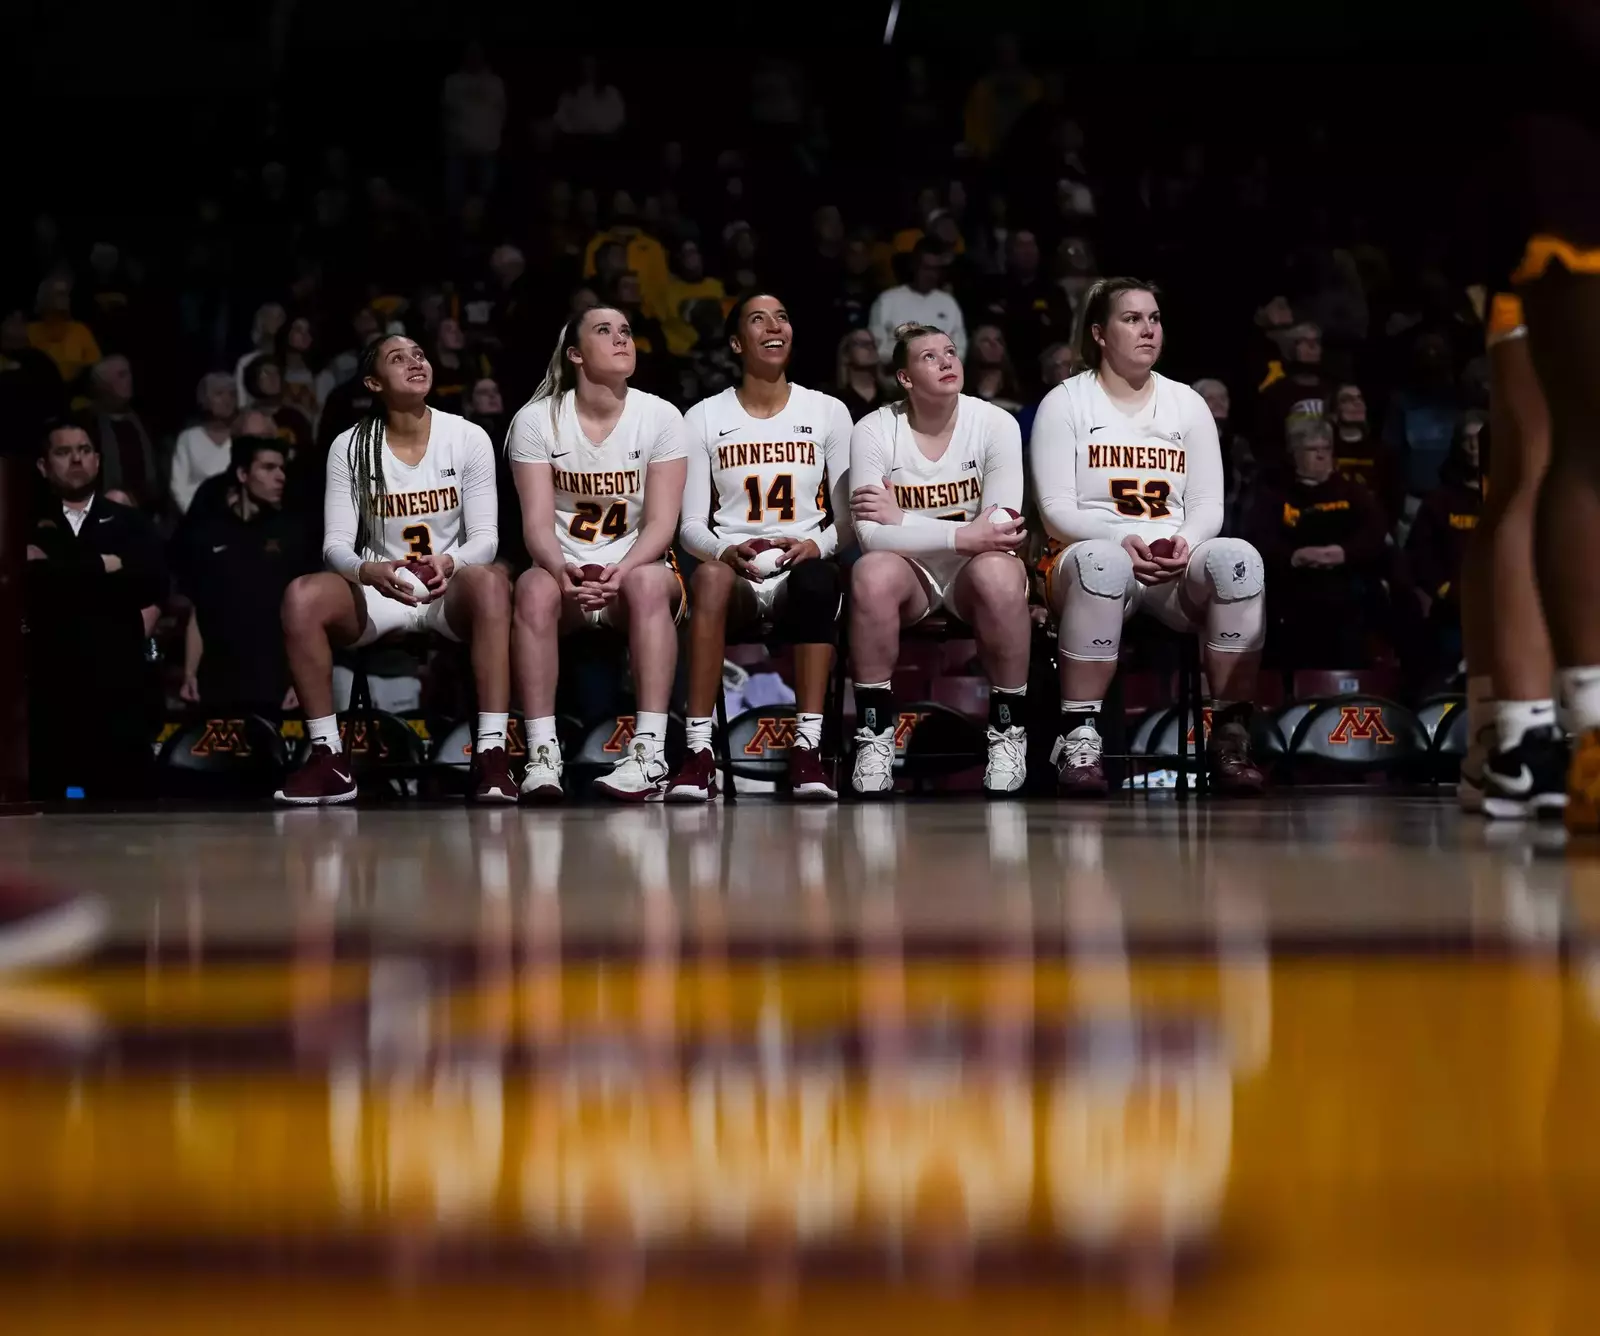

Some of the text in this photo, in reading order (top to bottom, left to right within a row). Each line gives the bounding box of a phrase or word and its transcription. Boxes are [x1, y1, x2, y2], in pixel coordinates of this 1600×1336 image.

[718, 441, 816, 470] MINNESOTA
[1089, 444, 1186, 474] MINNESOTA
[744, 474, 795, 523] 14
[894, 476, 981, 509] INNESOTA
[1109, 478, 1171, 520] 52
[402, 522, 433, 563] 3
[569, 500, 629, 545] 24
[191, 719, 251, 757] M
[1329, 705, 1396, 745] M
